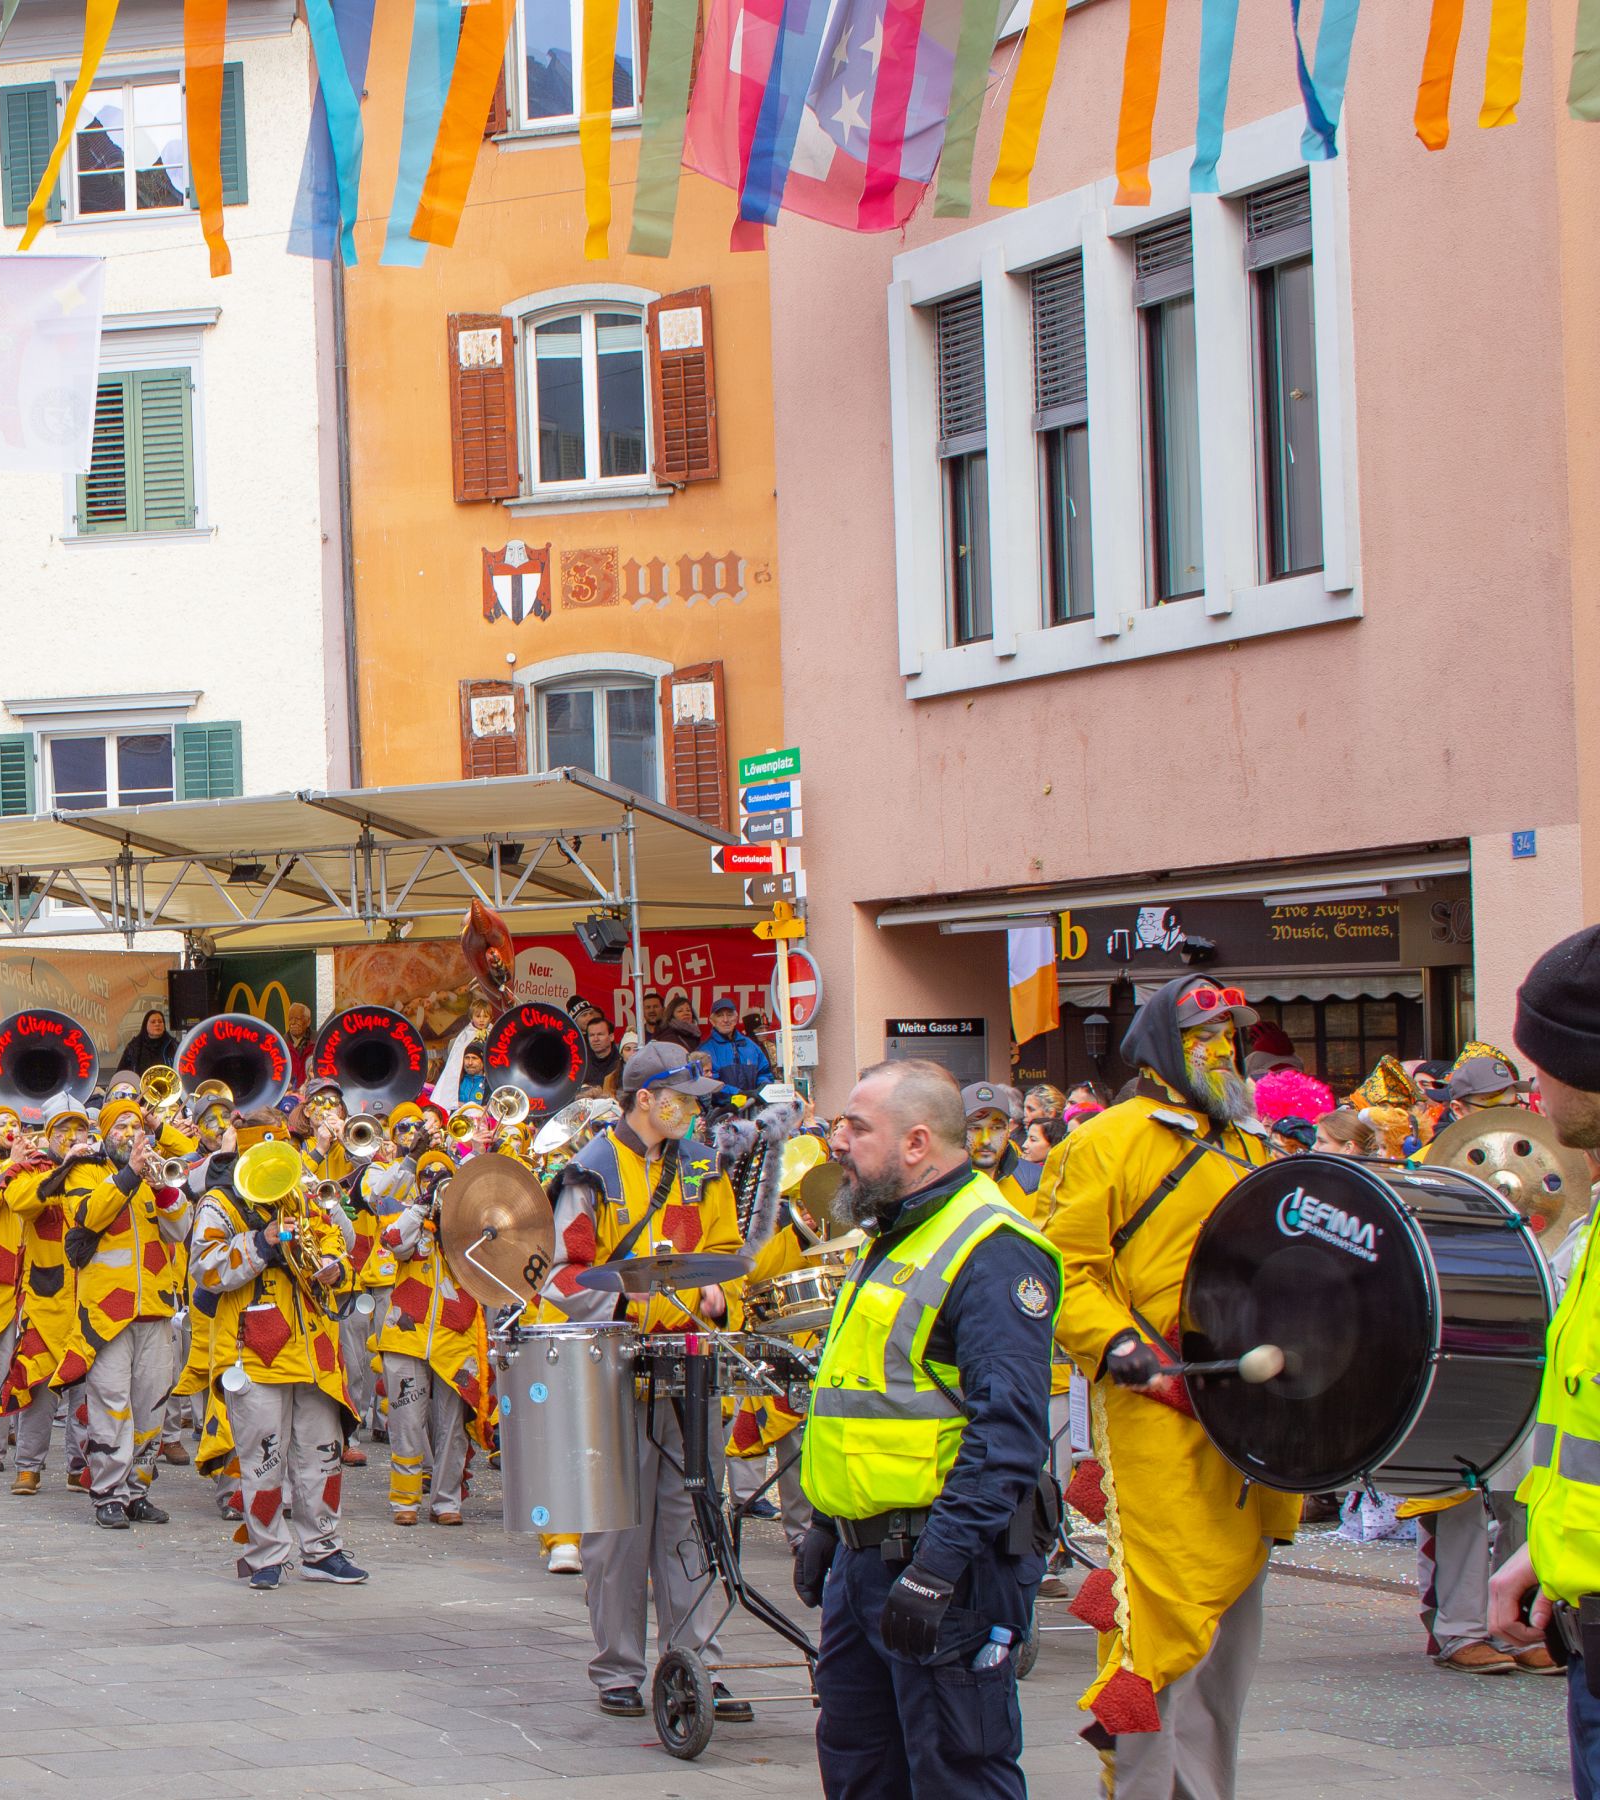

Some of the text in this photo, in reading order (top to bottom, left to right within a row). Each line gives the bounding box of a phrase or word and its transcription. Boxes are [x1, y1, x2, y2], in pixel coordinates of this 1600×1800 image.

[744, 756, 794, 777] Löwenplatz
[748, 791, 790, 803] Schlossbergplatz
[750, 822, 772, 834] Bahnhof
[1516, 835, 1531, 851] 34
[731, 854, 776, 865] Cordulaplat
[762, 882, 776, 894] WC
[1272, 922, 1394, 941] Music, Games,
[529, 962, 554, 978] Neu:
[898, 1022, 973, 1033] Weite Gasse 34
[17, 1014, 63, 1036] Clique
[64, 1029, 94, 1079] Baden
[178, 1020, 288, 1082] Bloser Clique Baden
[317, 1013, 423, 1078] Bloser Clique Baden
[488, 1007, 584, 1082] Bloser Clique Baden
[1019, 1068, 1046, 1079] Point
[900, 1577, 941, 1600] SECURITY
